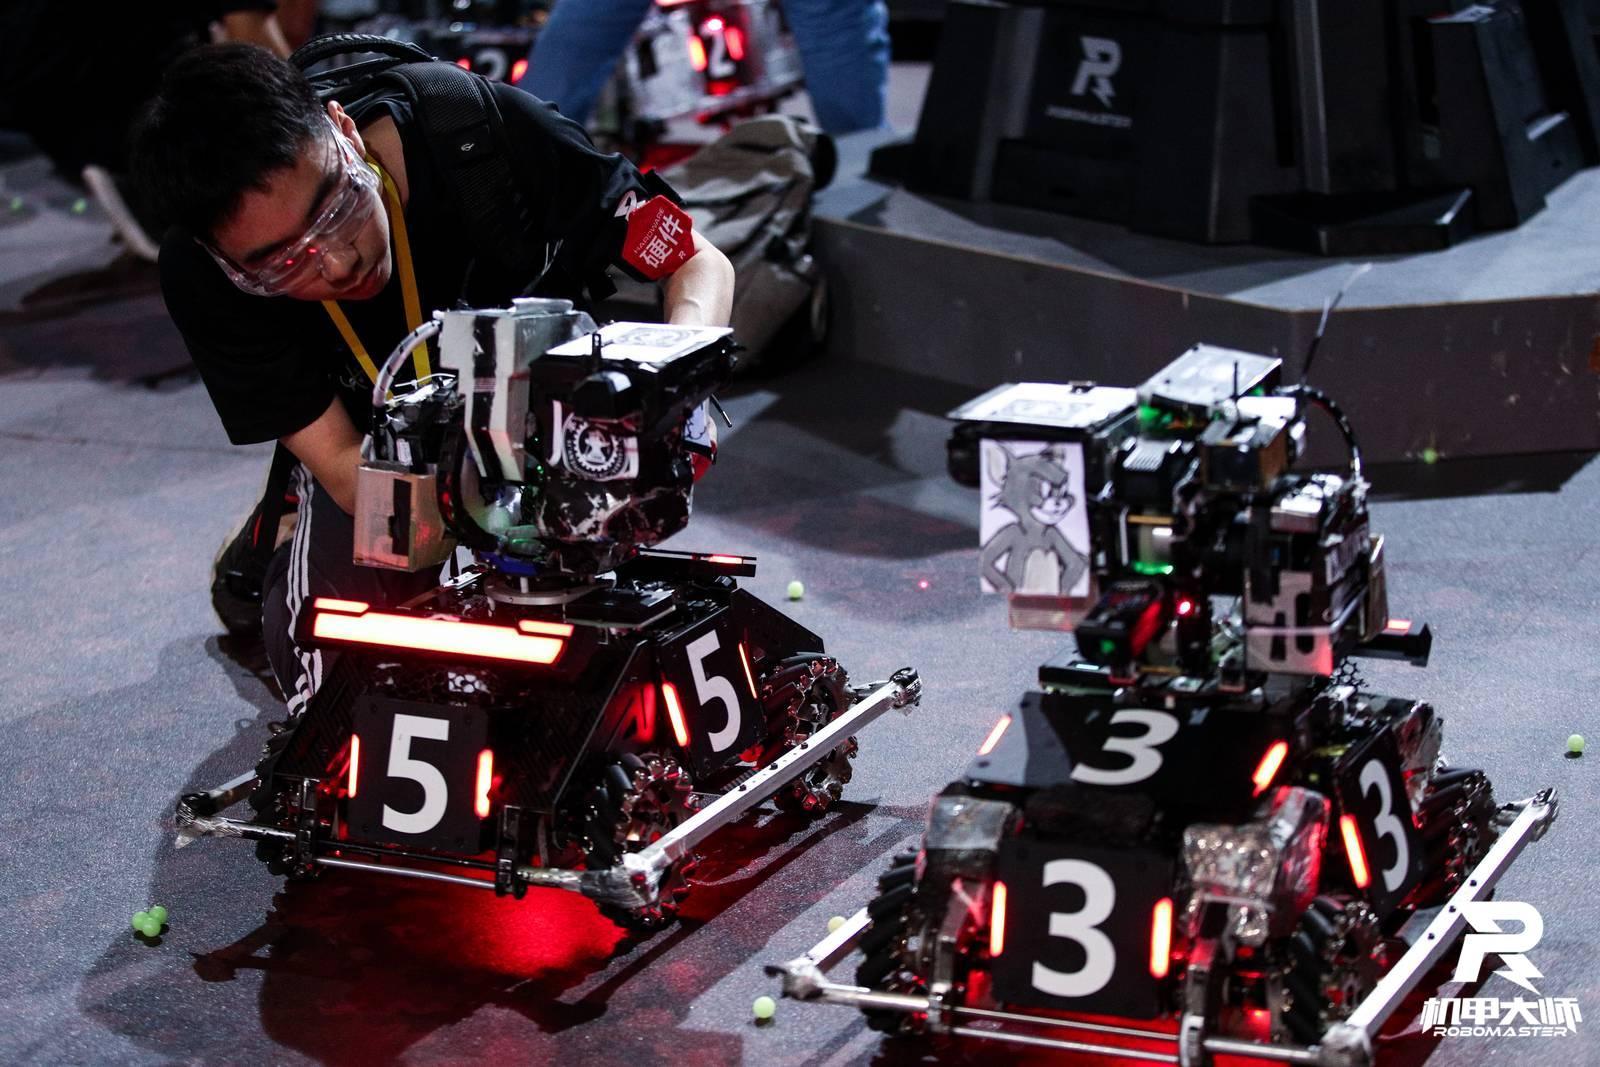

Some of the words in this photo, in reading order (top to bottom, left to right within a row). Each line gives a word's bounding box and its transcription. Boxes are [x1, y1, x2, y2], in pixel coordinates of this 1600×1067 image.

[639, 213, 684, 268] 硬件
[686, 629, 741, 752] 5
[1070, 709, 1179, 786] 3
[382, 713, 450, 834] 5
[1360, 758, 1409, 892] 3
[1032, 858, 1116, 997] 3
